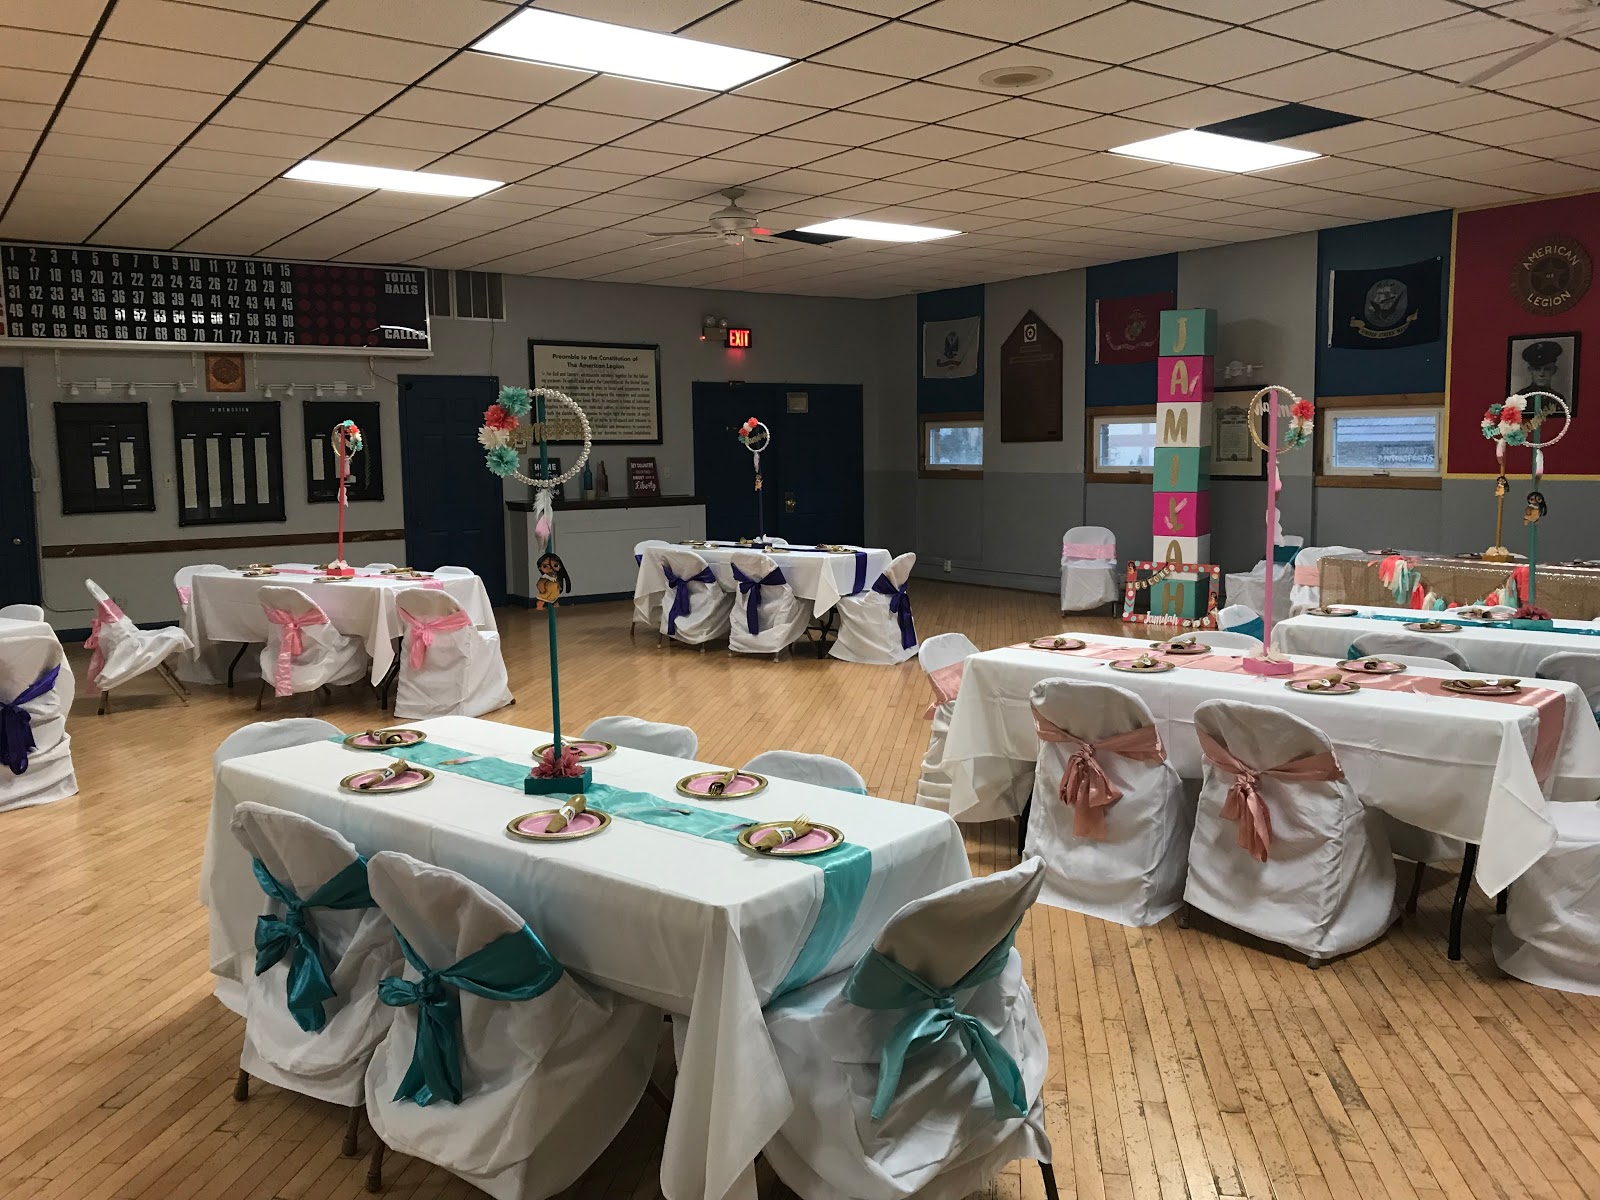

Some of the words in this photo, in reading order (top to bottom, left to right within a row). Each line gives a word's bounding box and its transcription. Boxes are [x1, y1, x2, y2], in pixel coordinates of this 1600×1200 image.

[9, 248, 15, 260] 1
[29, 249, 36, 261] 2
[50, 250, 58, 263] 3
[71, 251, 78, 264] 4
[92, 253, 99, 265] 5
[112, 254, 120, 266] 6
[133, 255, 139, 267] 7
[152, 256, 160, 268] 8
[171, 258, 179, 270] 9
[189, 259, 199, 271] 10
[209, 260, 217, 272] 11
[226, 261, 236, 273] 12
[245, 262, 255, 274] 13
[263, 263, 272, 275] 14
[280, 264, 290, 276] 15
[1523, 245, 1580, 271] AMERICAN
[7, 266, 19, 279] 16
[29, 268, 39, 280] 17
[50, 268, 61, 281] 18
[71, 269, 82, 282] 19
[90, 271, 103, 283] 20
[112, 272, 122, 285] 21
[131, 273, 144, 286] 22
[151, 274, 163, 287] 23
[170, 275, 183, 288] 24
[190, 276, 202, 289] 25
[209, 277, 220, 290] 26
[227, 278, 237, 290] 27
[245, 279, 256, 292] 28
[263, 280, 274, 292] 29
[281, 281, 291, 293] 30
[385, 272, 417, 283] TOTAL
[9, 285, 20, 298] 31
[29, 286, 43, 299] 32
[50, 287, 63, 300] 33
[71, 288, 84, 301] 34
[92, 289, 105, 302] 35
[112, 290, 125, 303] 36
[133, 291, 144, 304] 37
[152, 292, 165, 305] 38
[172, 293, 184, 305] 39
[191, 294, 203, 306] 40
[211, 295, 221, 307] 41
[228, 296, 239, 308] 42
[247, 297, 258, 309] 43
[264, 297, 275, 309] 44
[282, 298, 293, 310] 45
[385, 283, 419, 295] BALLS
[1527, 289, 1572, 308] LEGION
[10, 304, 23, 317] 46
[31, 305, 43, 318] 47
[52, 305, 65, 318] 48
[73, 306, 86, 319] 49
[93, 307, 106, 320] 50
[115, 308, 125, 321] 51
[134, 309, 146, 321] 52
[154, 310, 166, 322] 53
[173, 310, 185, 323] 54
[192, 311, 204, 324] 55
[211, 312, 223, 324] 56
[229, 313, 240, 325] 57
[247, 313, 259, 326] 58
[265, 314, 276, 326] 59
[283, 315, 294, 327] 60
[12, 323, 23, 336] 61
[32, 323, 46, 336] 62
[54, 324, 67, 337] 63
[74, 324, 87, 337] 64
[95, 325, 108, 338] 65
[115, 326, 128, 339] 66
[136, 327, 147, 339] 67
[155, 327, 168, 340] 68
[174, 328, 186, 340] 69
[194, 329, 205, 341] 70
[213, 329, 222, 342] 71
[231, 330, 242, 342] 72
[249, 330, 259, 343] 73
[266, 331, 277, 343] 74
[284, 332, 294, 344] 75
[729, 329, 750, 347] EXIT
[552, 353, 580, 361] Preamble
[634, 480, 657, 492] Liberty
[1127, 567, 1170, 590] WELCOME
[1143, 610, 1179, 626] Jamilah
